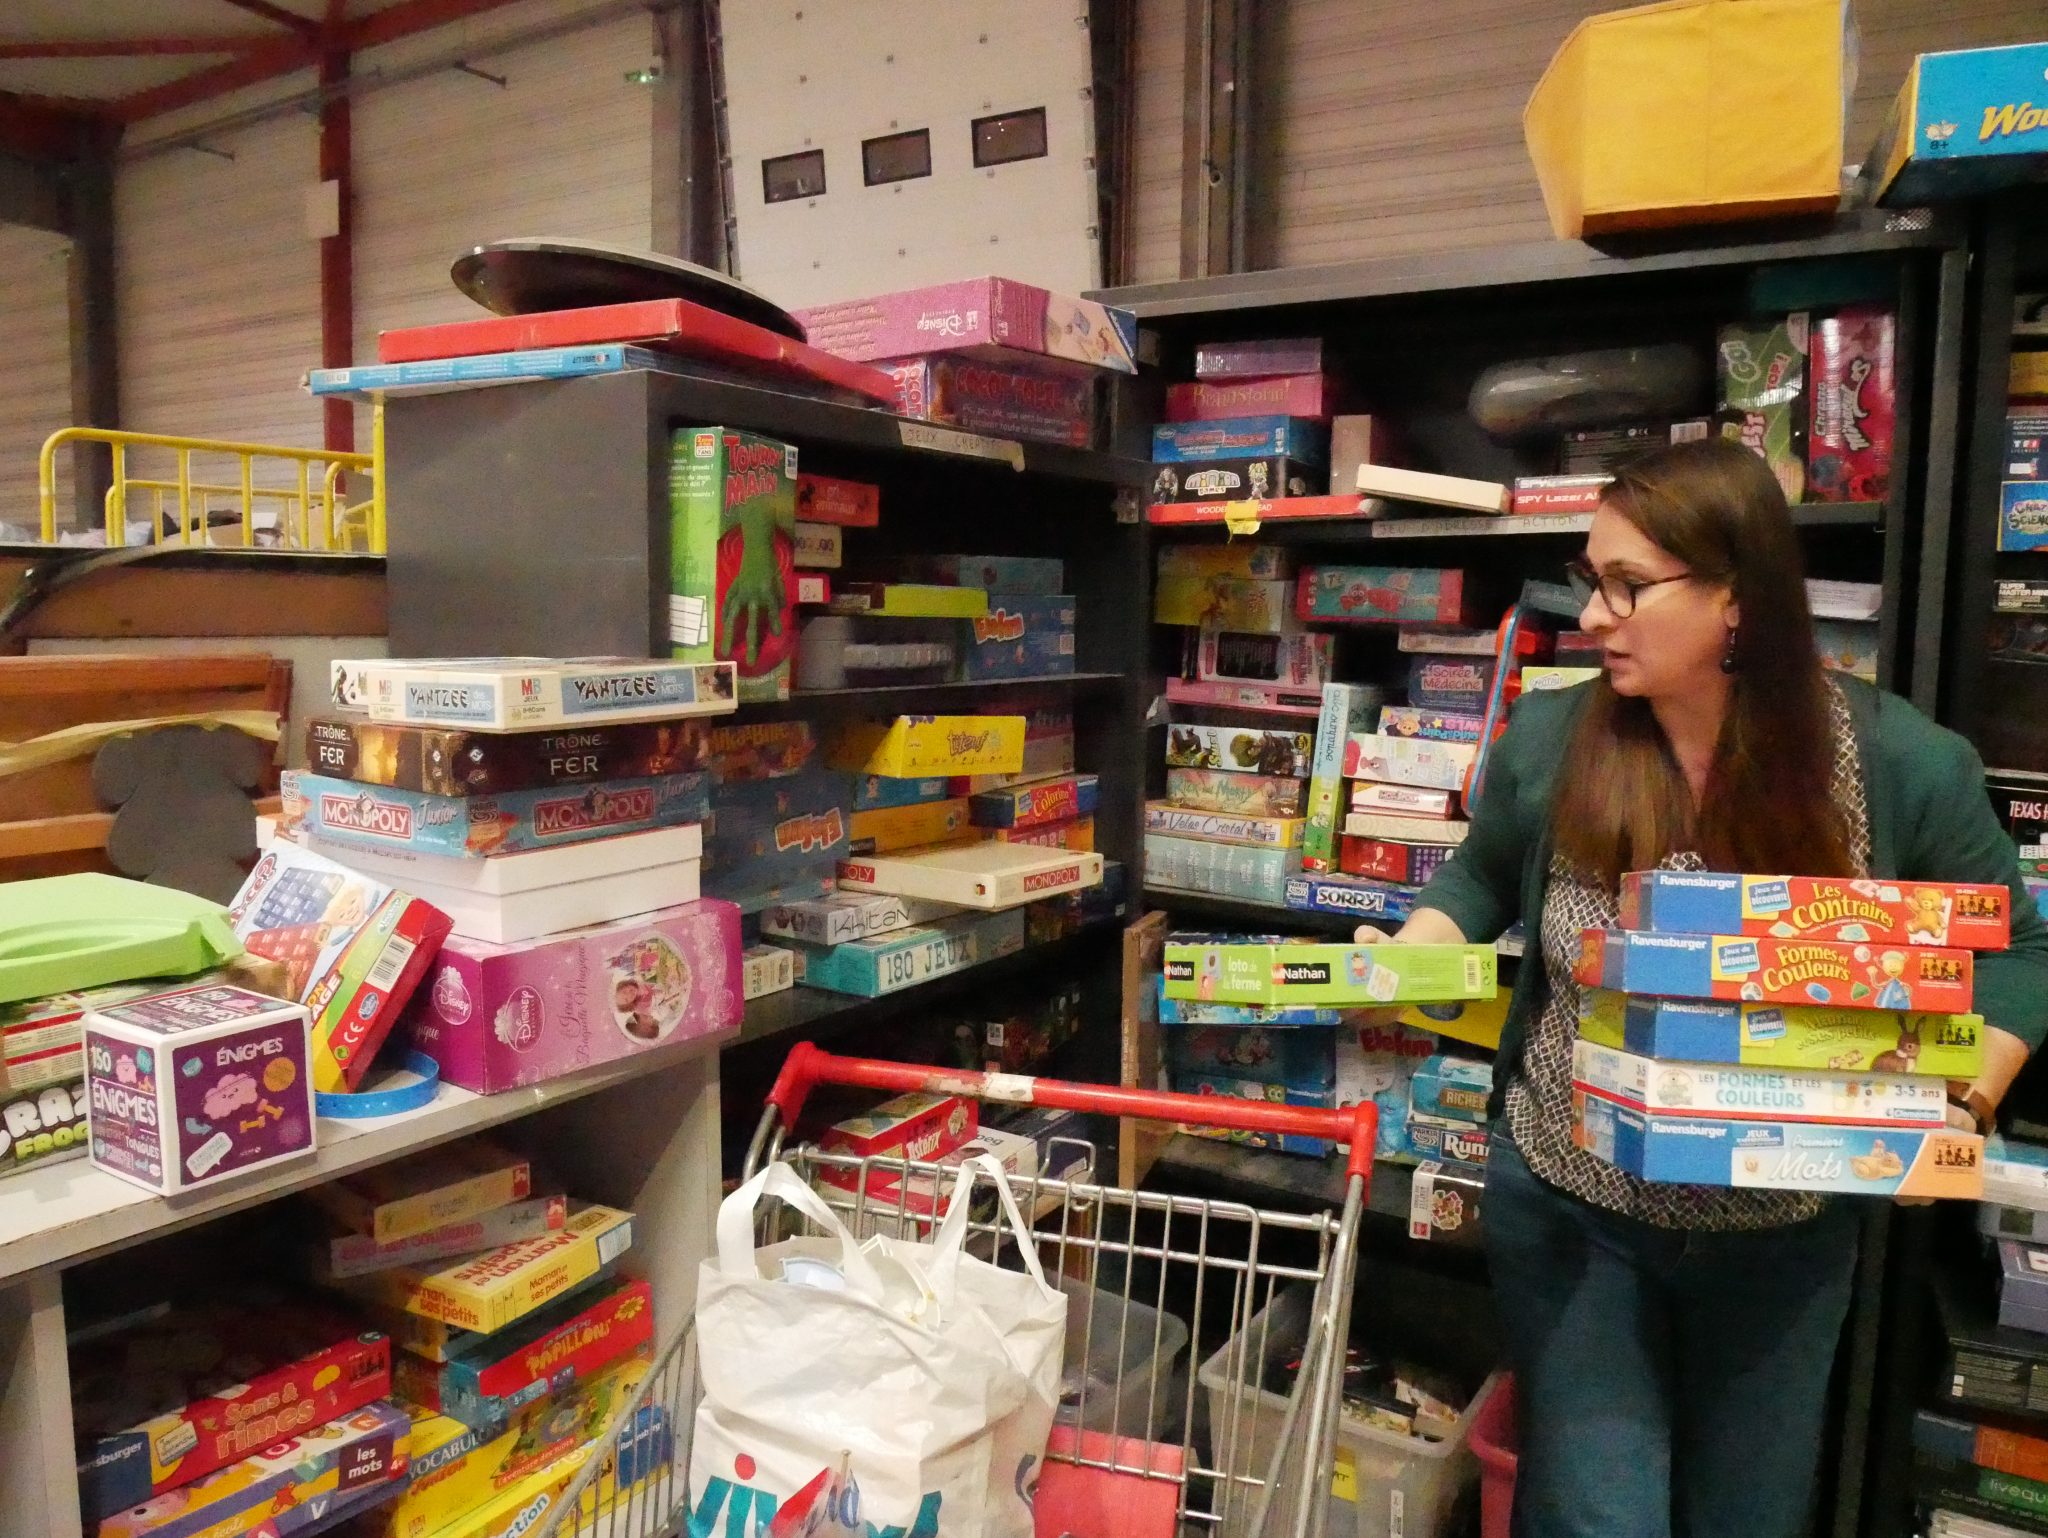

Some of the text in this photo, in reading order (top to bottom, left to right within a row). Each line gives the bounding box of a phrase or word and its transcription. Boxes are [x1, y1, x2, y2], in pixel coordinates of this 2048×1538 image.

[1978, 102, 2048, 141] Wo
[1518, 495, 1543, 504] SPY
[1196, 506, 1226, 514] WOODE
[521, 678, 542, 696] MB
[574, 676, 657, 700] YAHTZEE
[1423, 679, 1481, 690] Médecine
[320, 746, 345, 766] FER
[550, 755, 599, 776] FER
[2010, 799, 2041, 820] TEXAS
[1025, 867, 1079, 892] MONOPOLY
[1659, 875, 1737, 890] Ravensburger
[1812, 882, 1841, 900] Les
[1792, 895, 1896, 930] Contraires
[1631, 934, 1707, 950] Ravensburger
[887, 934, 971, 986] 180 JEUX
[1228, 955, 1248, 973] loto
[1775, 945, 1840, 966] Formes
[1169, 966, 1193, 977] Nathan
[1282, 967, 1327, 980] Nathan
[1763, 961, 1851, 993] Couleurs
[1231, 976, 1263, 991] ferme
[1662, 1001, 1737, 1017] Ravensburger
[91, 1046, 112, 1073] 150
[1699, 1073, 1822, 1089] LES FORMES ET LES
[1716, 1089, 1805, 1109] COULEURS
[1894, 1085, 1940, 1098] 3-5 ans
[0, 1083, 87, 1157] RAZ
[1651, 1122, 1728, 1139] Ravensburger
[1444, 1133, 1490, 1160] Rum
[1767, 1150, 1843, 1182] Mots
[528, 1264, 562, 1291] Maman
[530, 1273, 569, 1303] ses petits
[442, 1302, 480, 1327] petits
[223, 1383, 299, 1427] Sons &
[215, 1399, 317, 1460] rimes
[357, 1447, 377, 1463] les
[348, 1460, 384, 1479] mots
[310, 1500, 327, 1521] V
